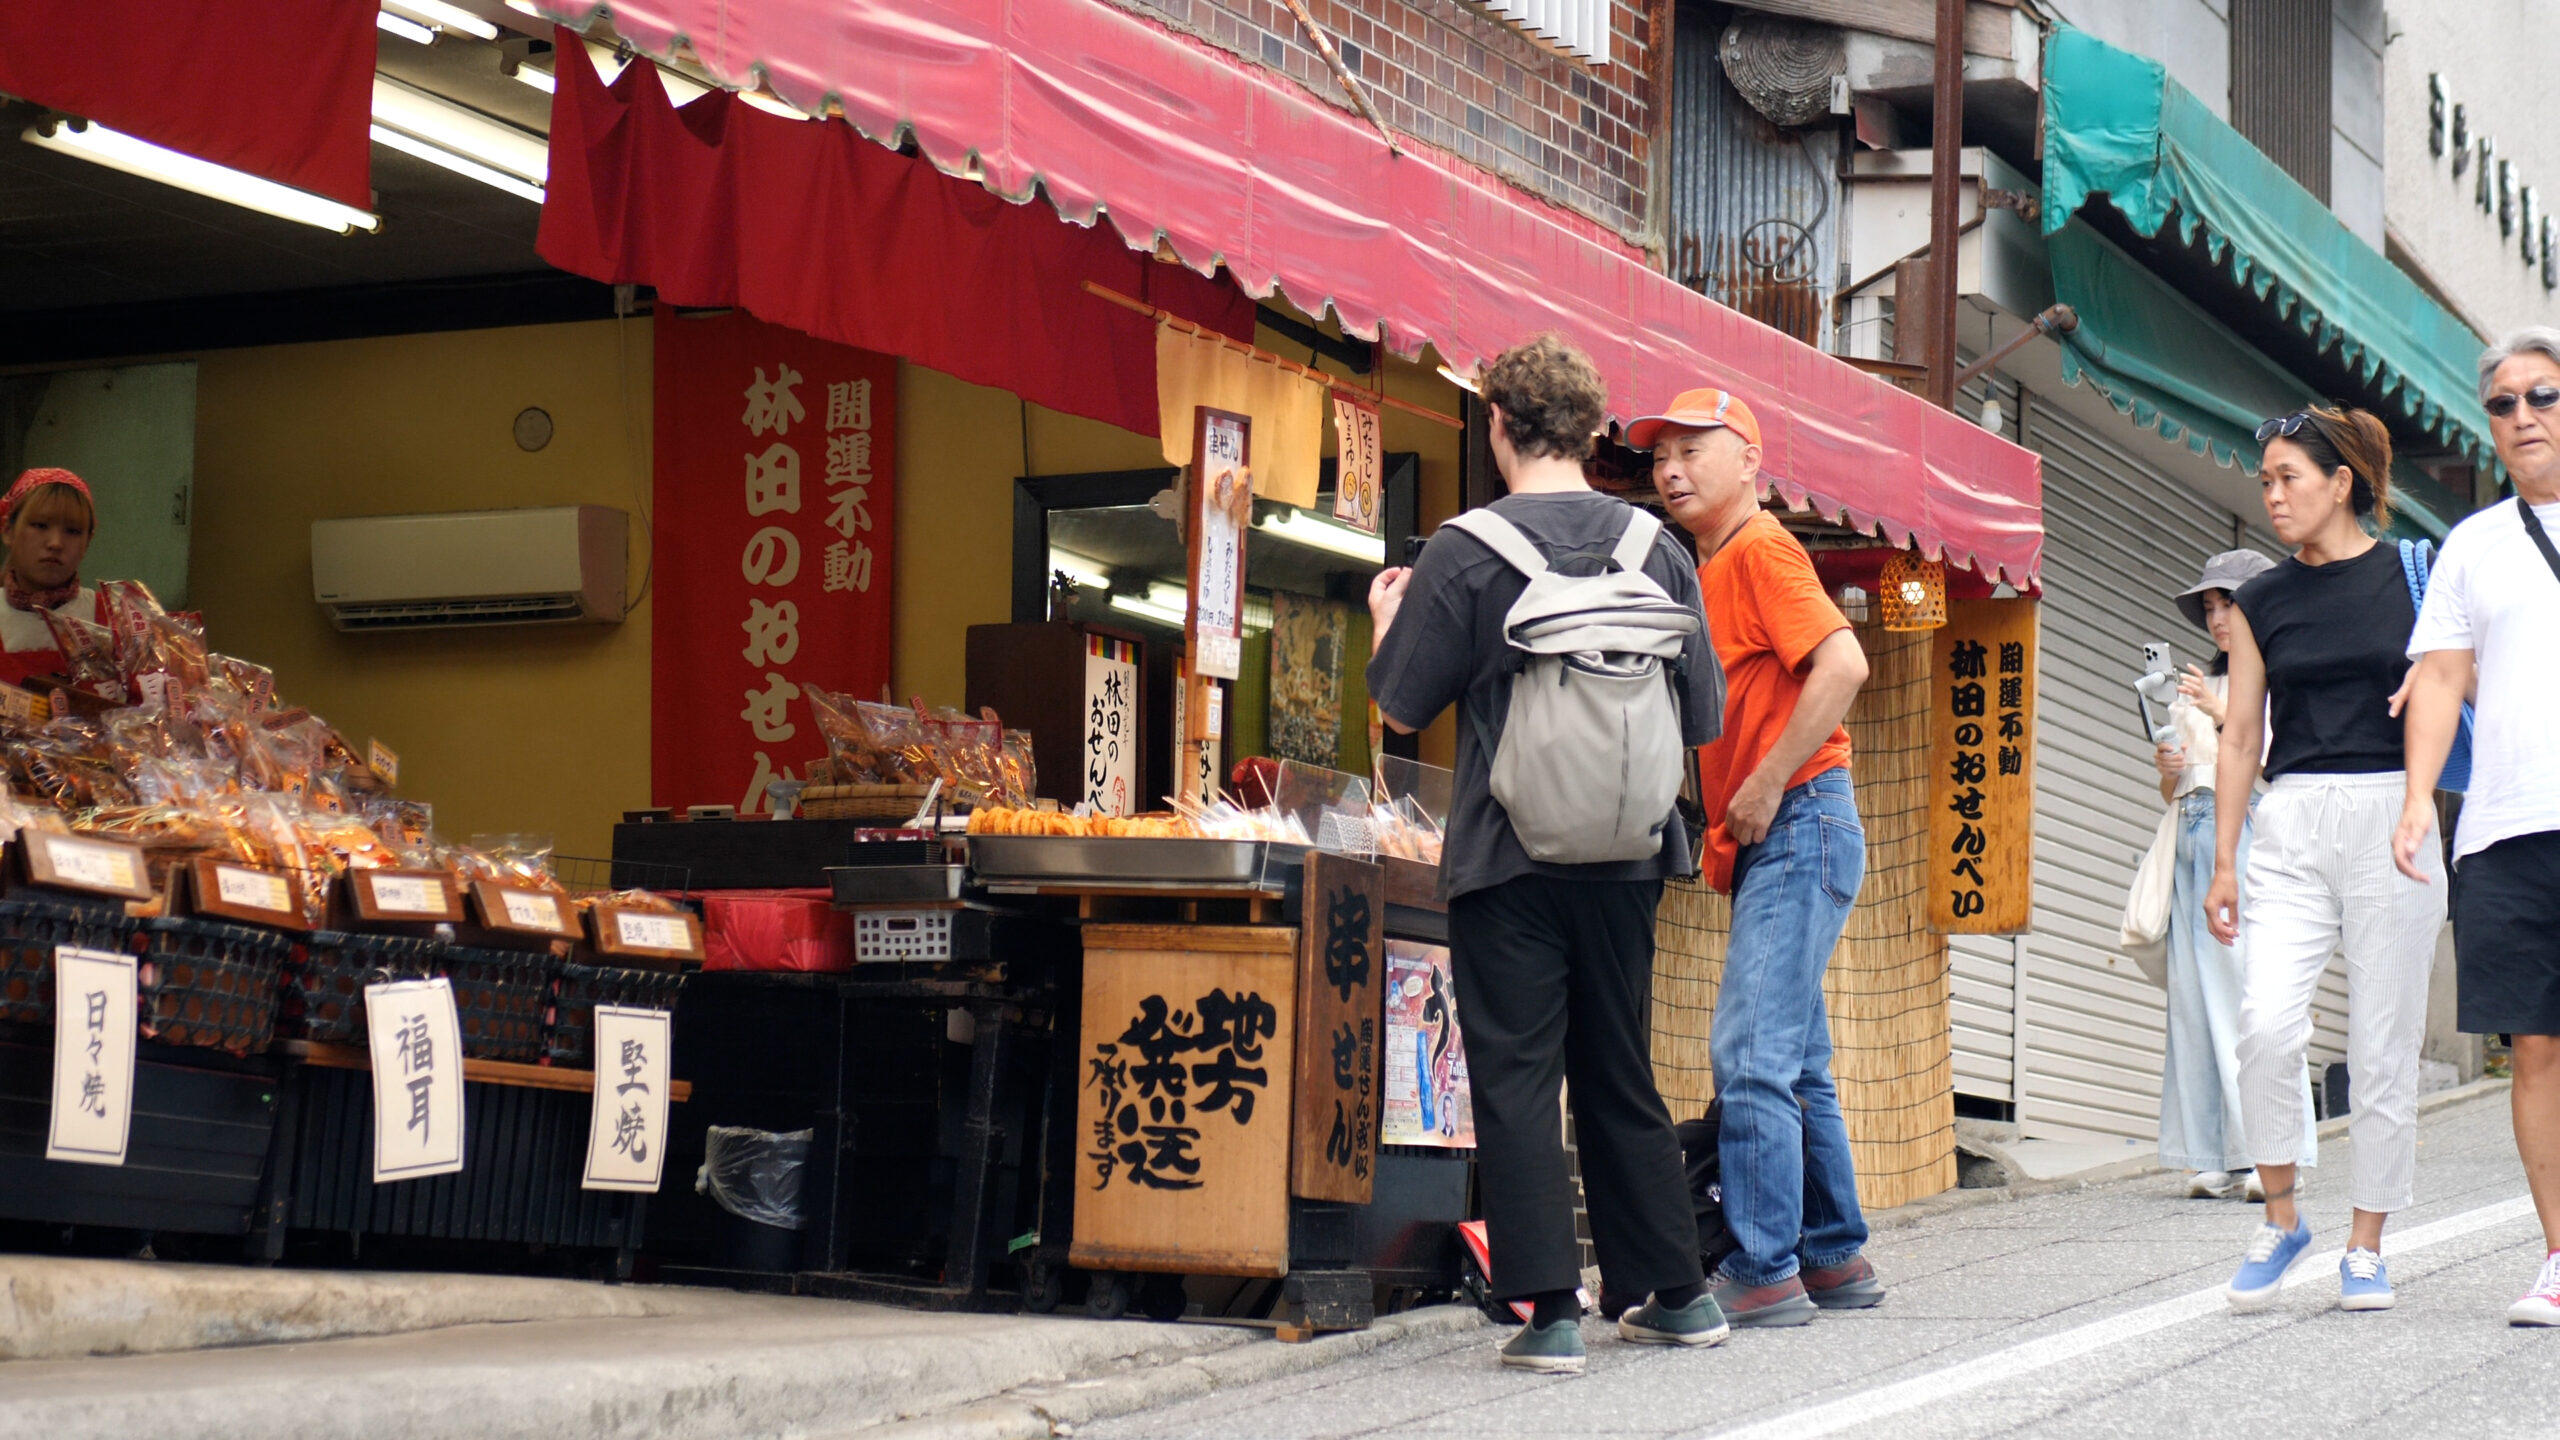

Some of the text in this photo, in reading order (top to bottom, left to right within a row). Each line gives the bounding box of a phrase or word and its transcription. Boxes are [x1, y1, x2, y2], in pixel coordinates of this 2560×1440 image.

[822, 377, 873, 594] 開運不動
[1208, 427, 1240, 463] 串せん
[1340, 401, 1355, 468] しょうゆ
[1361, 412, 1374, 480] みたらし
[740, 362, 806, 815] 林田のおせん
[1224, 541, 1234, 606] みたらし
[1087, 694, 1107, 817] おせんべ
[1104, 669, 1124, 765] 林田の
[1998, 641, 2024, 777] 開運不動
[1948, 639, 1988, 919] 林田のおせんべい
[77, 988, 107, 1120] 日々焼
[394, 1013, 435, 1149] 福耳
[1118, 994, 1204, 1191] 発送
[1192, 987, 1277, 1126] 地方
[1325, 884, 1371, 1169] 串せん
[610, 1039, 650, 1164] 堅焼
[1085, 1042, 1128, 1192] 承ります
